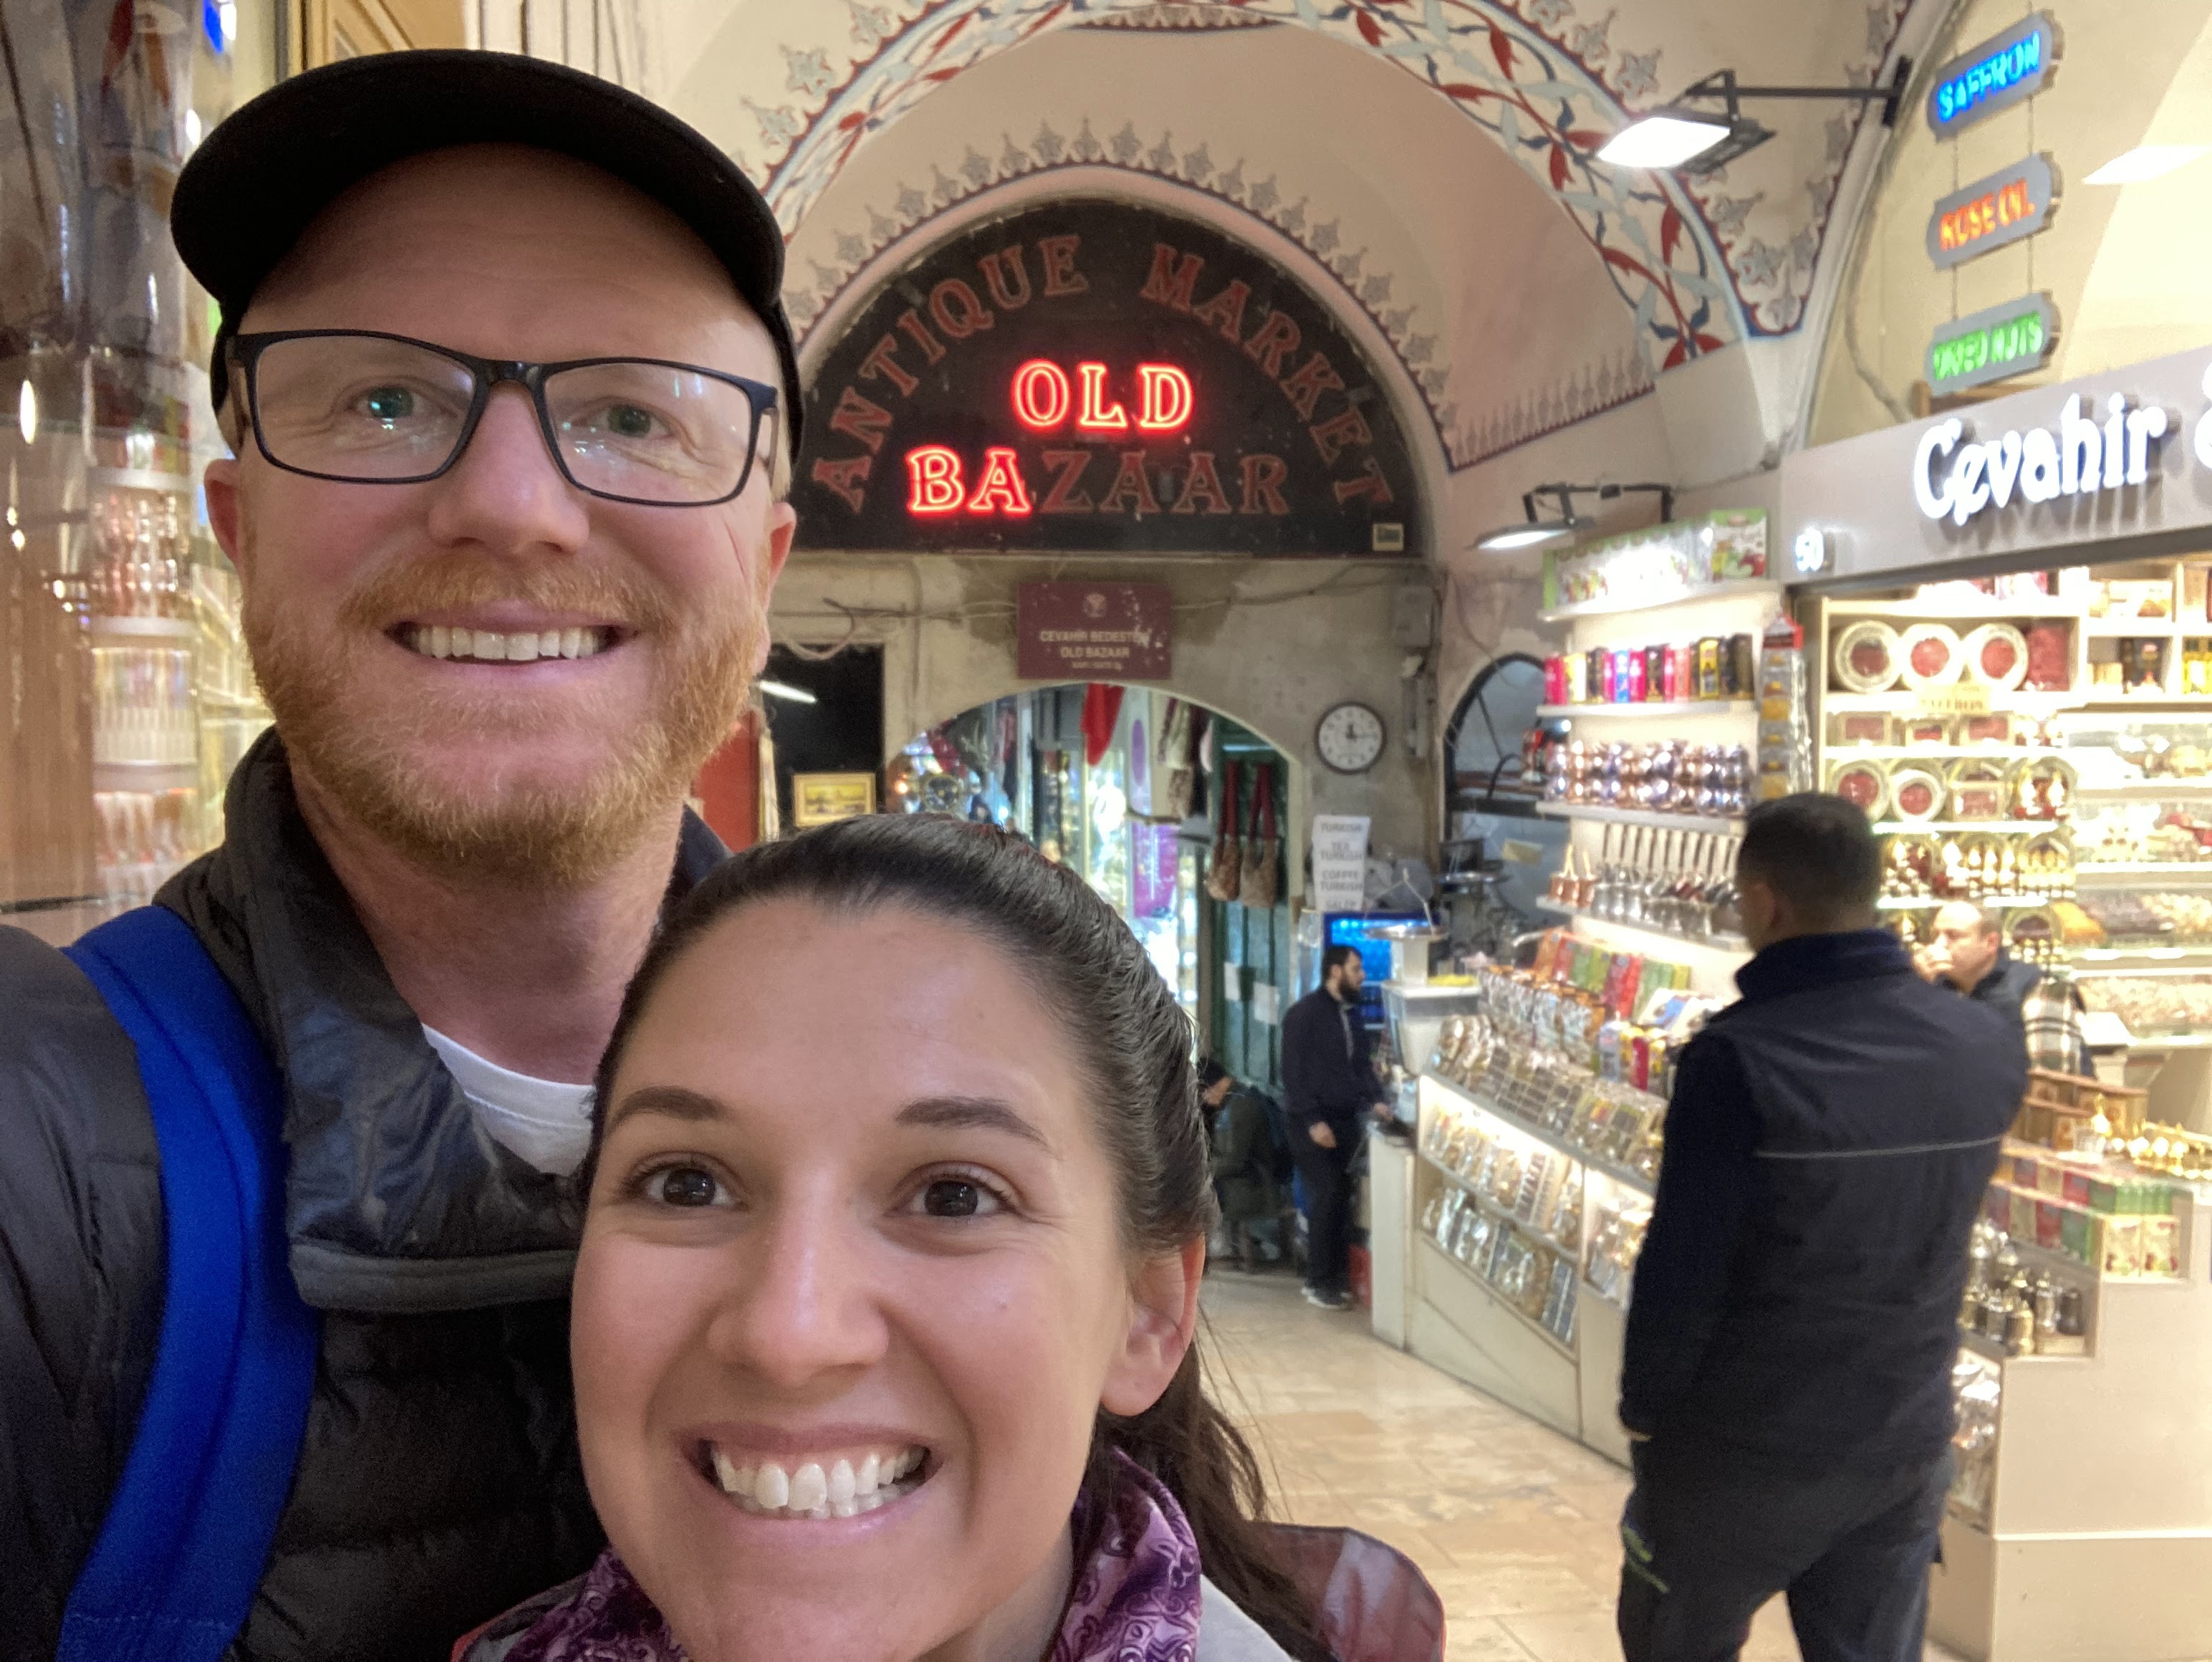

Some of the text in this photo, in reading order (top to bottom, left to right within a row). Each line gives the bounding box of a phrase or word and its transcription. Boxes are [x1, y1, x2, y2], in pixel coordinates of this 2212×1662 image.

[1938, 30, 2040, 123] SAFFRON
[1939, 192, 1996, 251] ROSE
[1990, 310, 2043, 363] NUTS
[812, 235, 1394, 514] ANTIQUE MARKET
[1013, 360, 1193, 430] OLD
[905, 446, 1290, 514] BAZAAR
[1914, 393, 2168, 526] Cevahir
[1060, 647, 1130, 658] OLD BAZAAR
